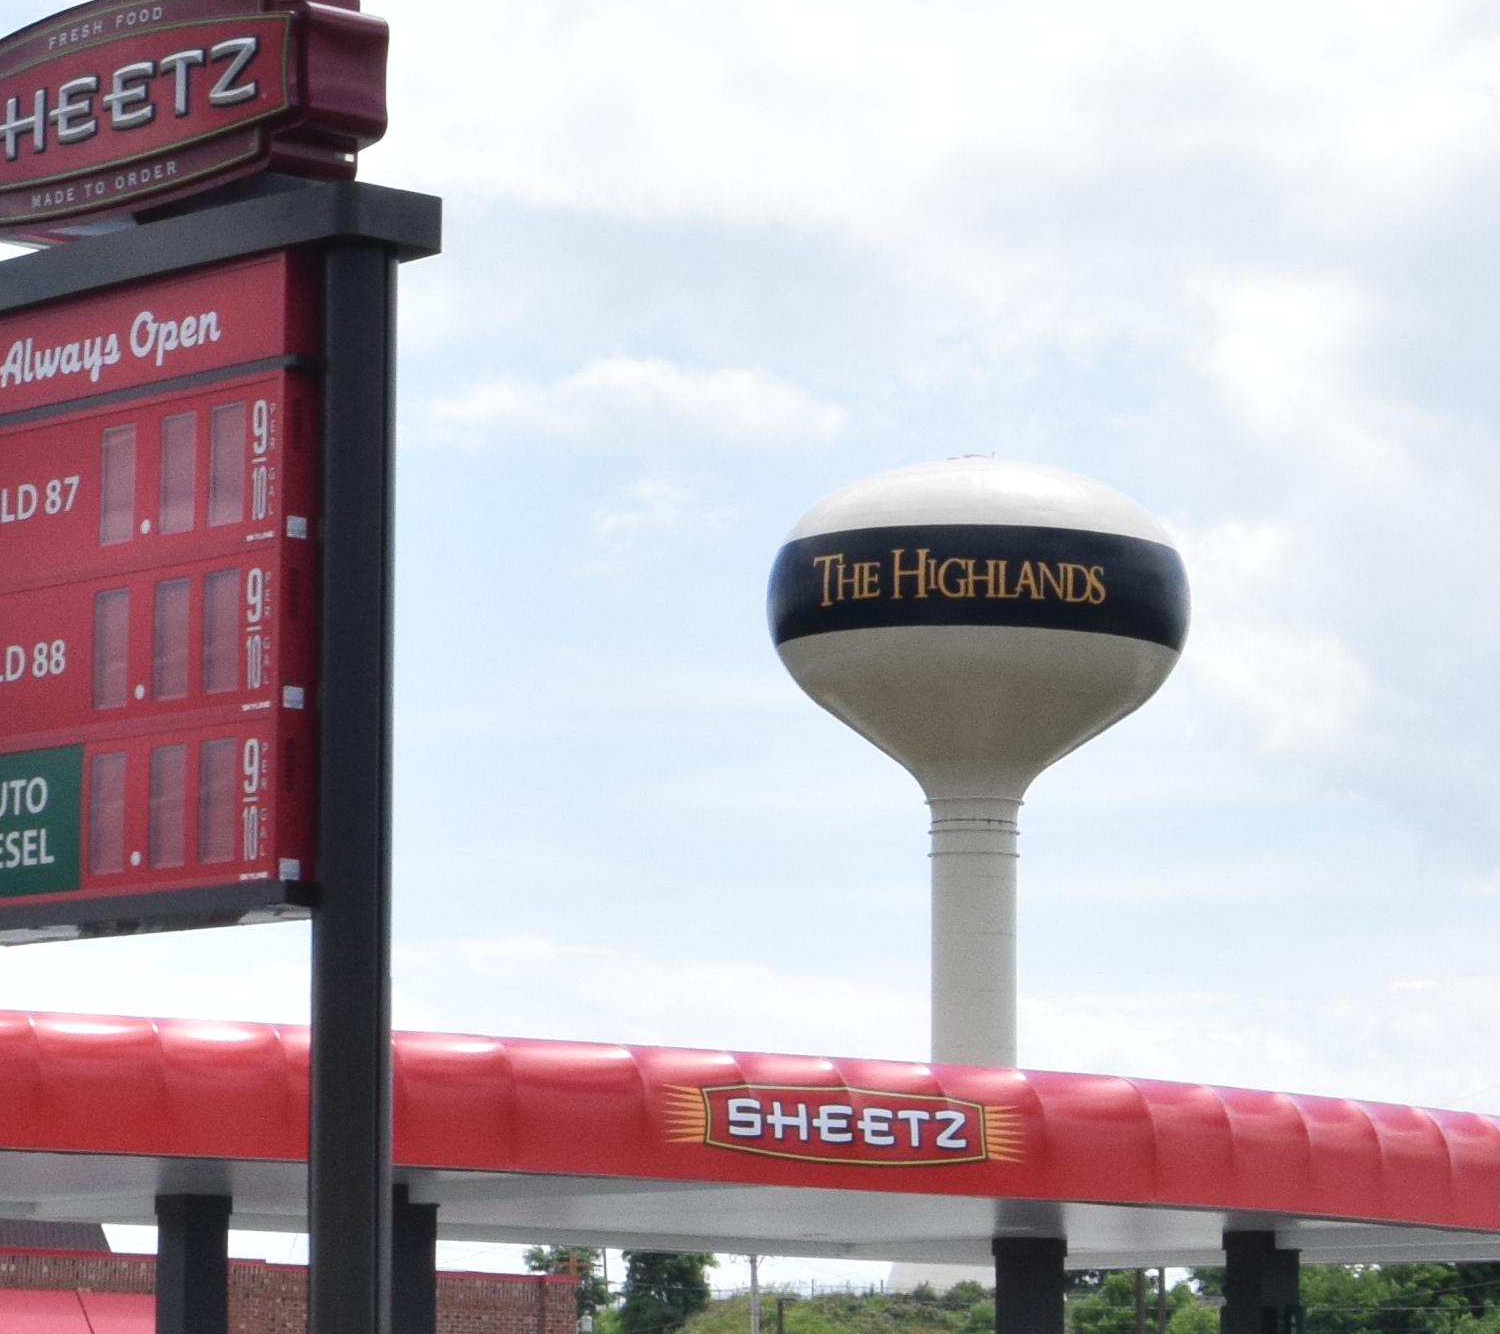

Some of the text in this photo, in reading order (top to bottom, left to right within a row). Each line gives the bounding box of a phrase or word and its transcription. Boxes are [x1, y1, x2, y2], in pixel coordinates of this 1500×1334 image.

[48, 7, 163, 50] FRESH FOOD
[31, 161, 177, 208] MADE TO ORDER
[130, 311, 222, 366] Open
[44, 475, 80, 514] 87
[813, 548, 1107, 607] THE HIGHLANDS
[31, 638, 67, 678] 88
[727, 1098, 967, 1148] SHEETZ
